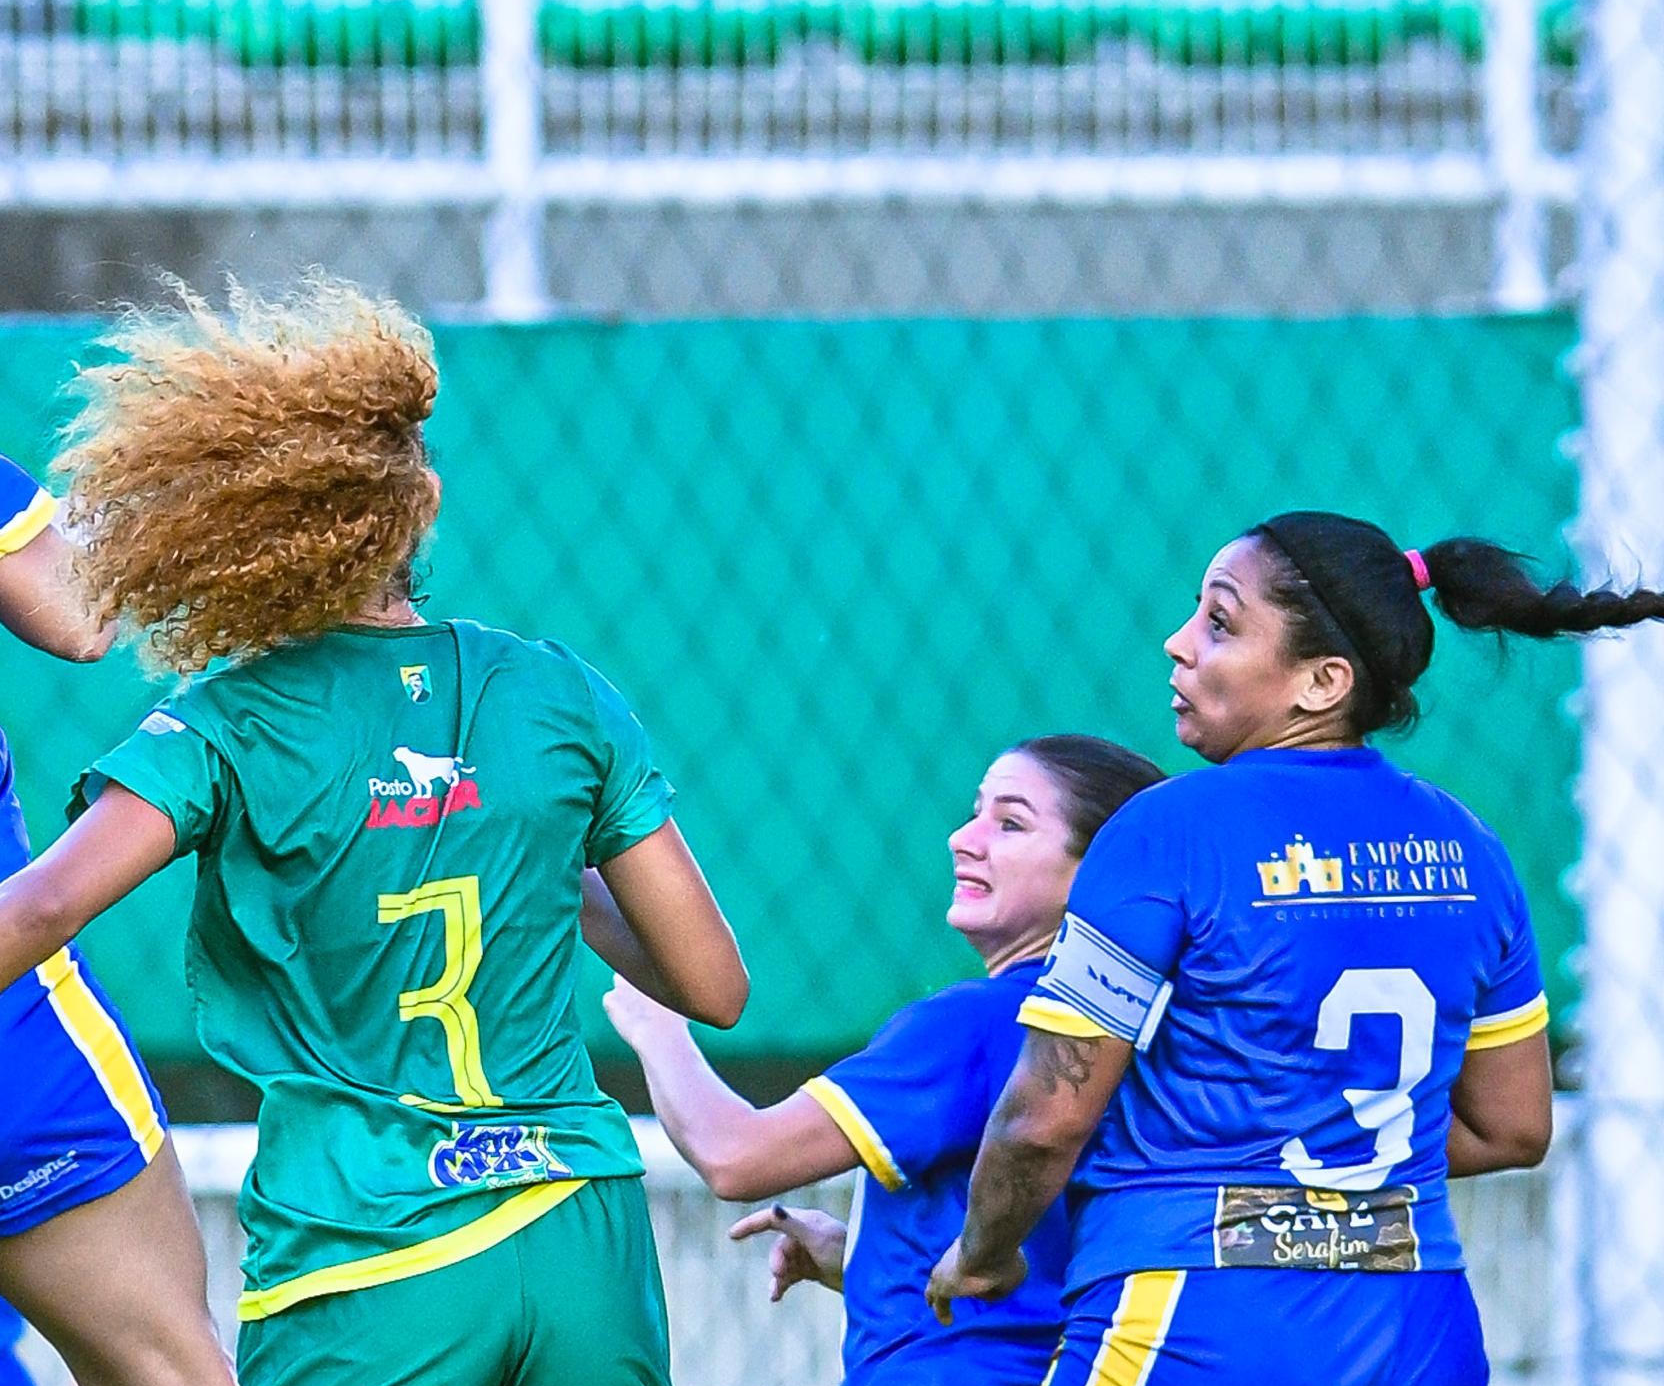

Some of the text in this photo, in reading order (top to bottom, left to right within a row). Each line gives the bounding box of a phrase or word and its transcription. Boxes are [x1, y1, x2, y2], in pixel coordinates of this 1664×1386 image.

[368, 777, 413, 797] Posto
[1348, 832, 1464, 866] EMPÓRIO
[1350, 865, 1469, 893] SERAFIM
[378, 874, 504, 1113] 3
[1279, 968, 1437, 1191] 3
[1273, 1227, 1370, 1269] Serafim
